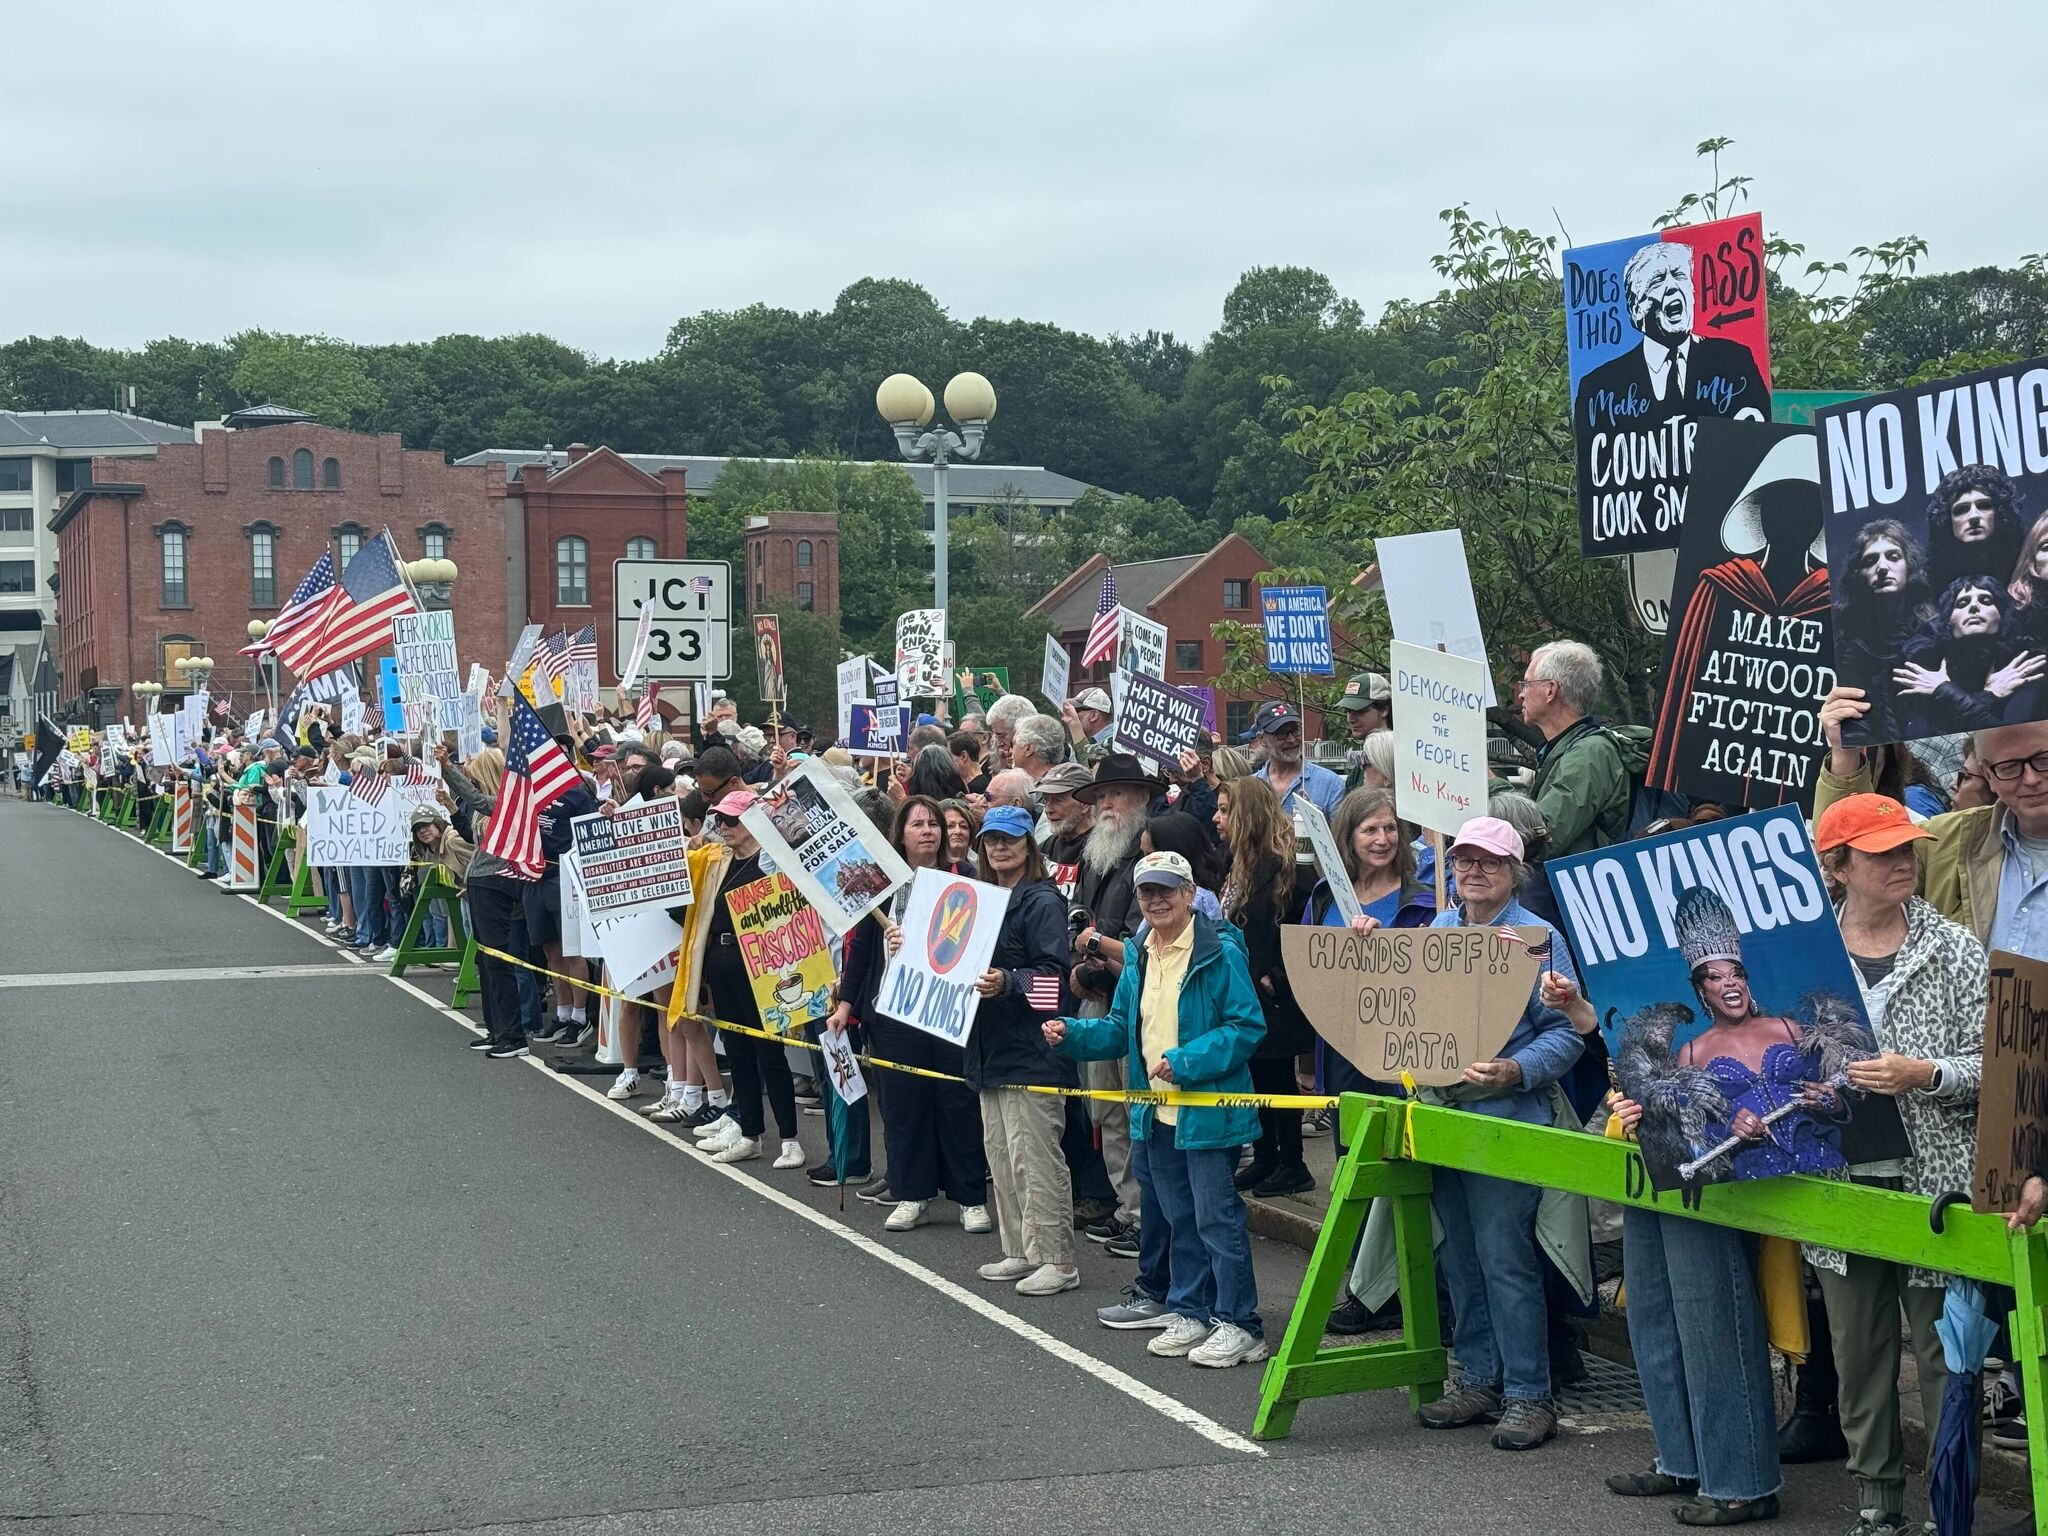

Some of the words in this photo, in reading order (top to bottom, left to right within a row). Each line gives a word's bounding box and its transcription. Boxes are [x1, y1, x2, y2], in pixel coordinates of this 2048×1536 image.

[1567, 262, 1619, 309] DOES
[1701, 227, 1760, 311] ASS
[1574, 305, 1622, 349] THIS
[1588, 382, 1650, 427] Make
[1591, 414, 1698, 488] COUNTR
[1825, 403, 1908, 514] NO
[1917, 368, 2048, 494] KING
[1592, 490, 1647, 541] LOOK
[1278, 597, 1287, 612] IN
[392, 616, 422, 645] DEAR
[420, 612, 453, 641] WORLD
[902, 636, 926, 649] END
[1134, 624, 1151, 644] COME
[1152, 632, 1163, 650] ON
[1266, 616, 1286, 639] WE
[1288, 615, 1325, 639] DON'T
[1728, 609, 1822, 653] MAKE
[422, 641, 454, 672] REALLY
[647, 629, 702, 661] 33
[1140, 644, 1161, 669] PEOPLE
[1268, 642, 1286, 664] DO
[1289, 642, 1329, 665] KINGS
[400, 674, 425, 704] SORRY
[1398, 669, 1484, 713] DEMOCRACY
[1701, 649, 1838, 701] ATWOOD
[1131, 681, 1167, 710] HATE
[1169, 697, 1199, 726] WILL
[1433, 712, 1448, 724] OF
[868, 731, 888, 743] NO
[1121, 718, 1141, 739] US
[1125, 699, 1156, 725] NOT
[1156, 713, 1197, 745] MAKE
[1433, 725, 1450, 738] THE
[867, 742, 888, 750] KINGS
[1416, 739, 1470, 773] PEOPLE
[1701, 739, 1810, 788] AGAIN
[1411, 772, 1430, 794] No
[1437, 780, 1471, 810] Kings
[329, 811, 386, 836] NEED
[613, 813, 623, 822] ALL
[625, 809, 644, 820] PEOPLE
[646, 806, 656, 815] ARE
[658, 802, 675, 812] EQUAL
[614, 818, 644, 838] LOVE
[649, 811, 680, 830] WINS
[576, 823, 589, 840] IN
[592, 819, 613, 837] OUR
[580, 836, 615, 853] AMERICA
[617, 836, 635, 847] BLACK
[637, 833, 654, 843] LIVES
[656, 827, 680, 840] MATTER
[646, 843, 656, 852] ARE
[657, 837, 683, 850] WELCOME
[798, 820, 849, 863] AMERICA
[375, 836, 409, 861] FLUSH
[584, 861, 627, 876] DISABILITIES
[629, 857, 643, 868] ARE
[644, 848, 683, 863] RESPECTED
[804, 851, 829, 872] FOR
[828, 827, 859, 854] SALE
[588, 892, 627, 909] DIVERSITY
[631, 890, 639, 900] IS
[642, 879, 690, 897] CELEBRATED
[726, 876, 775, 916] WAKE
[777, 871, 795, 892] U
[1555, 858, 1649, 966] NO
[1636, 817, 1823, 949] KINGS
[739, 905, 827, 980] FASCISM
[1308, 932, 1413, 975] HANDS
[1422, 932, 1512, 975] OFF!!
[887, 963, 925, 1017] NO
[920, 975, 976, 1039] KINGS
[1358, 986, 1417, 1027] OUR
[1383, 1030, 1459, 1071] DATA
